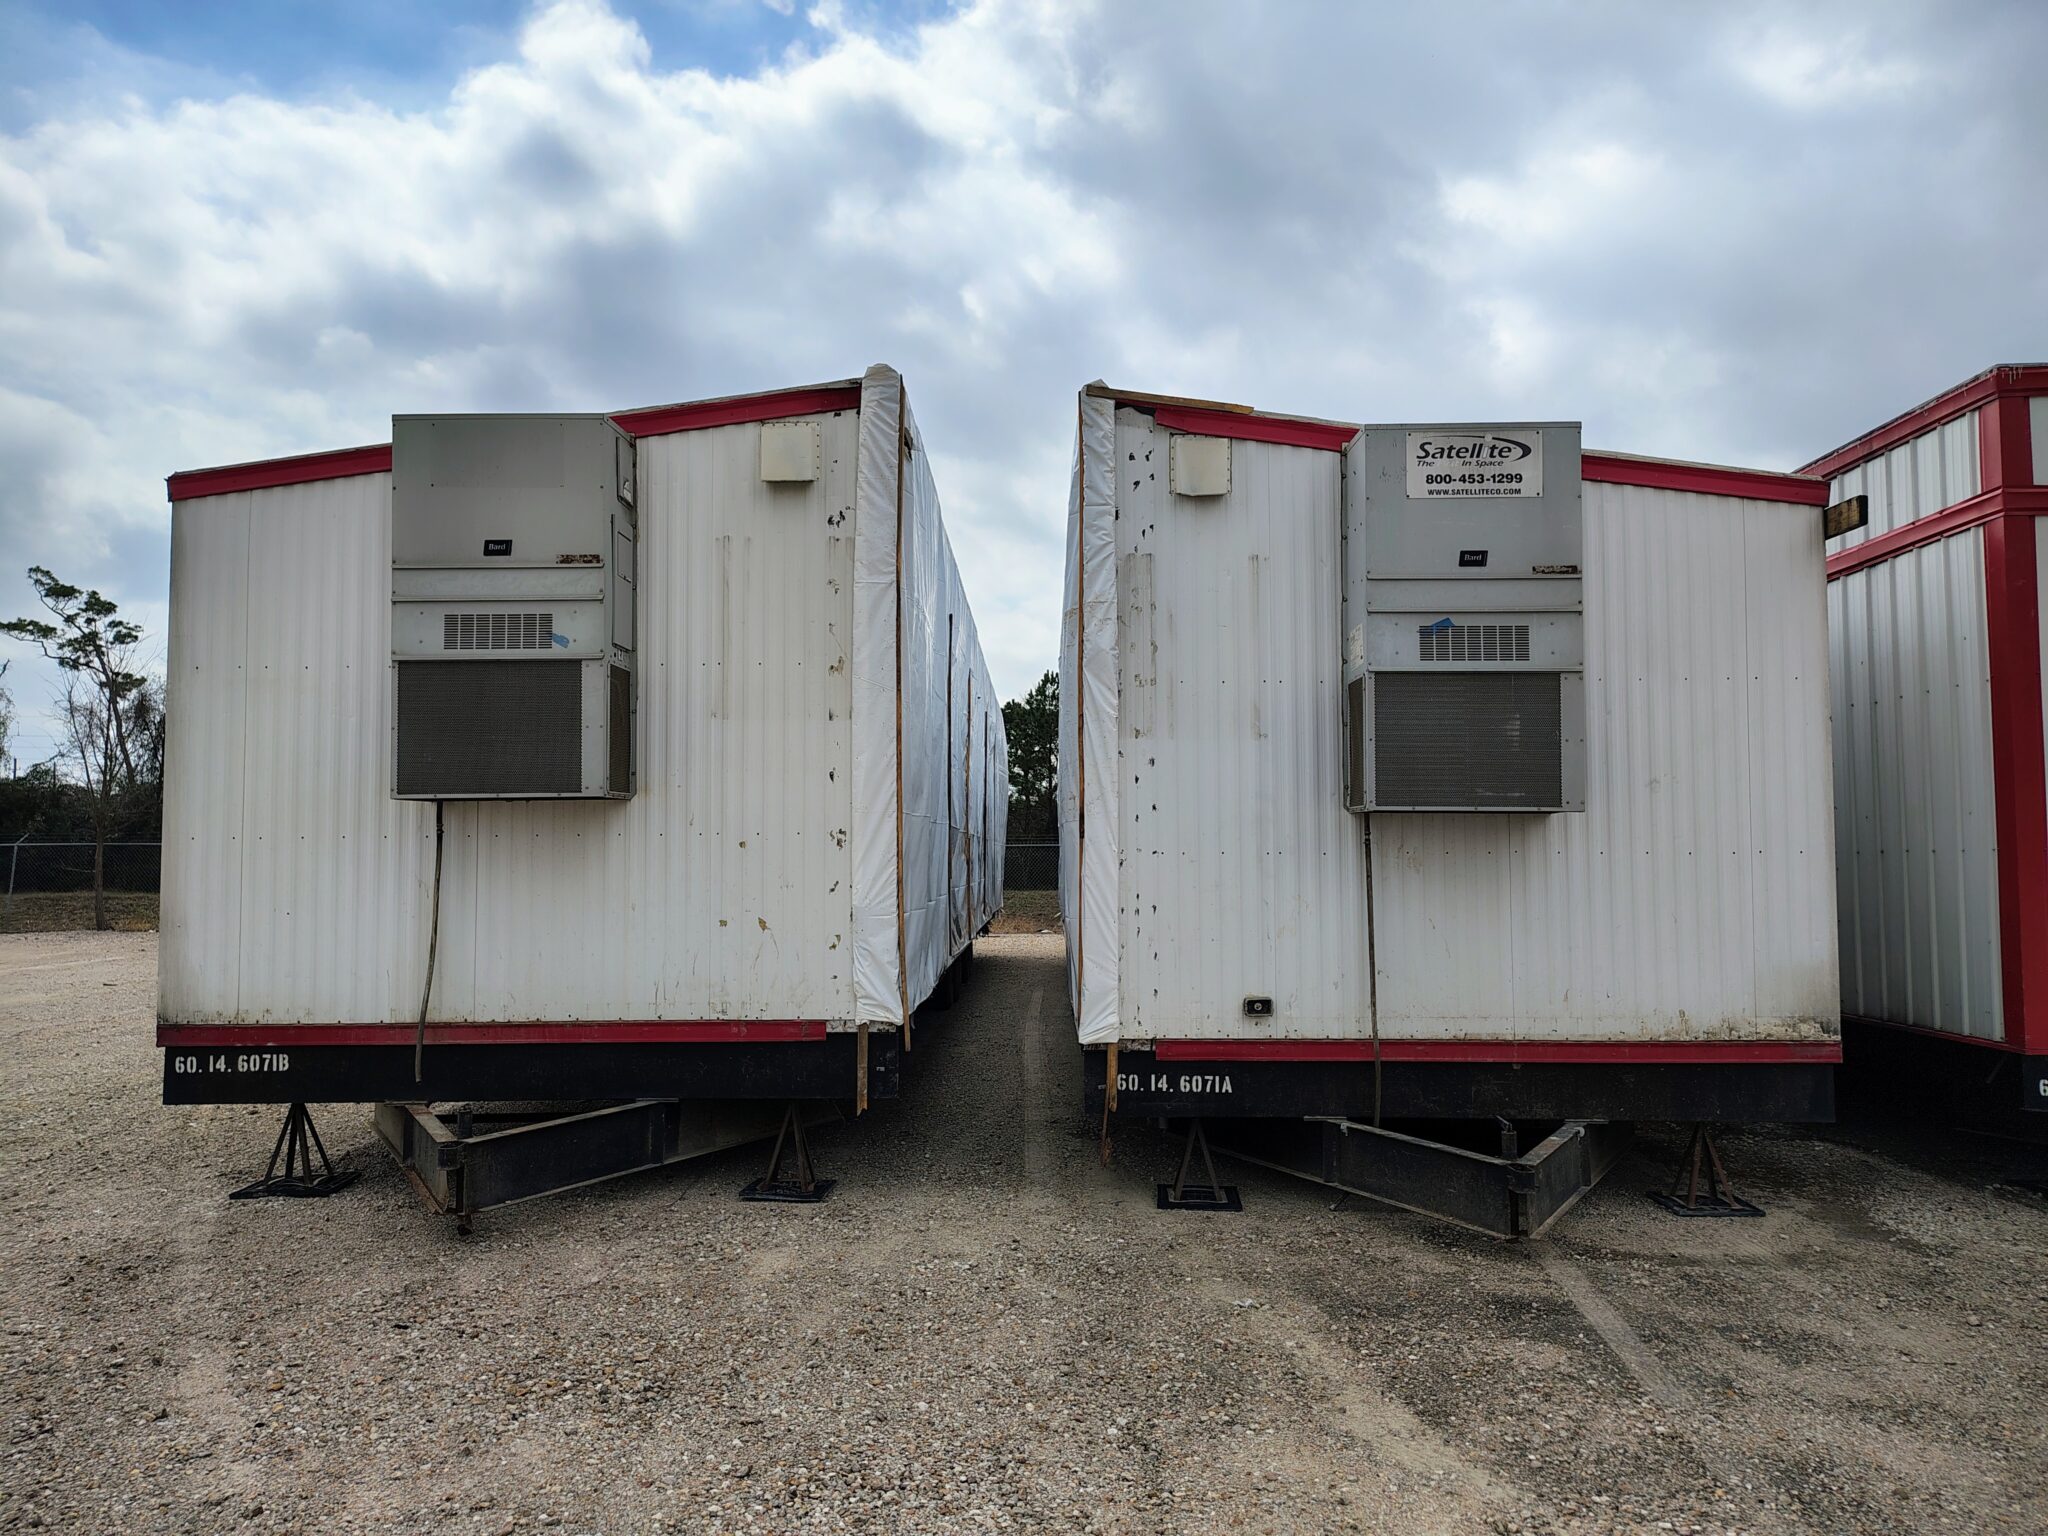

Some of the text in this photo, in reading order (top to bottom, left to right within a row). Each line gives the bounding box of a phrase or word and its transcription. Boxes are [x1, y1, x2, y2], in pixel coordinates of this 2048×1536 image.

[1416, 441, 1512, 460] Satellite
[1474, 460, 1505, 468] Space
[1425, 473, 1523, 485] 800-453-1299
[1427, 488, 1522, 497] WWW.SATELLITECO.COM
[488, 543, 506, 551] Bard
[175, 1054, 290, 1074] 60. 14. 6071B
[1116, 1073, 1233, 1093] 60. 14. 6071A
